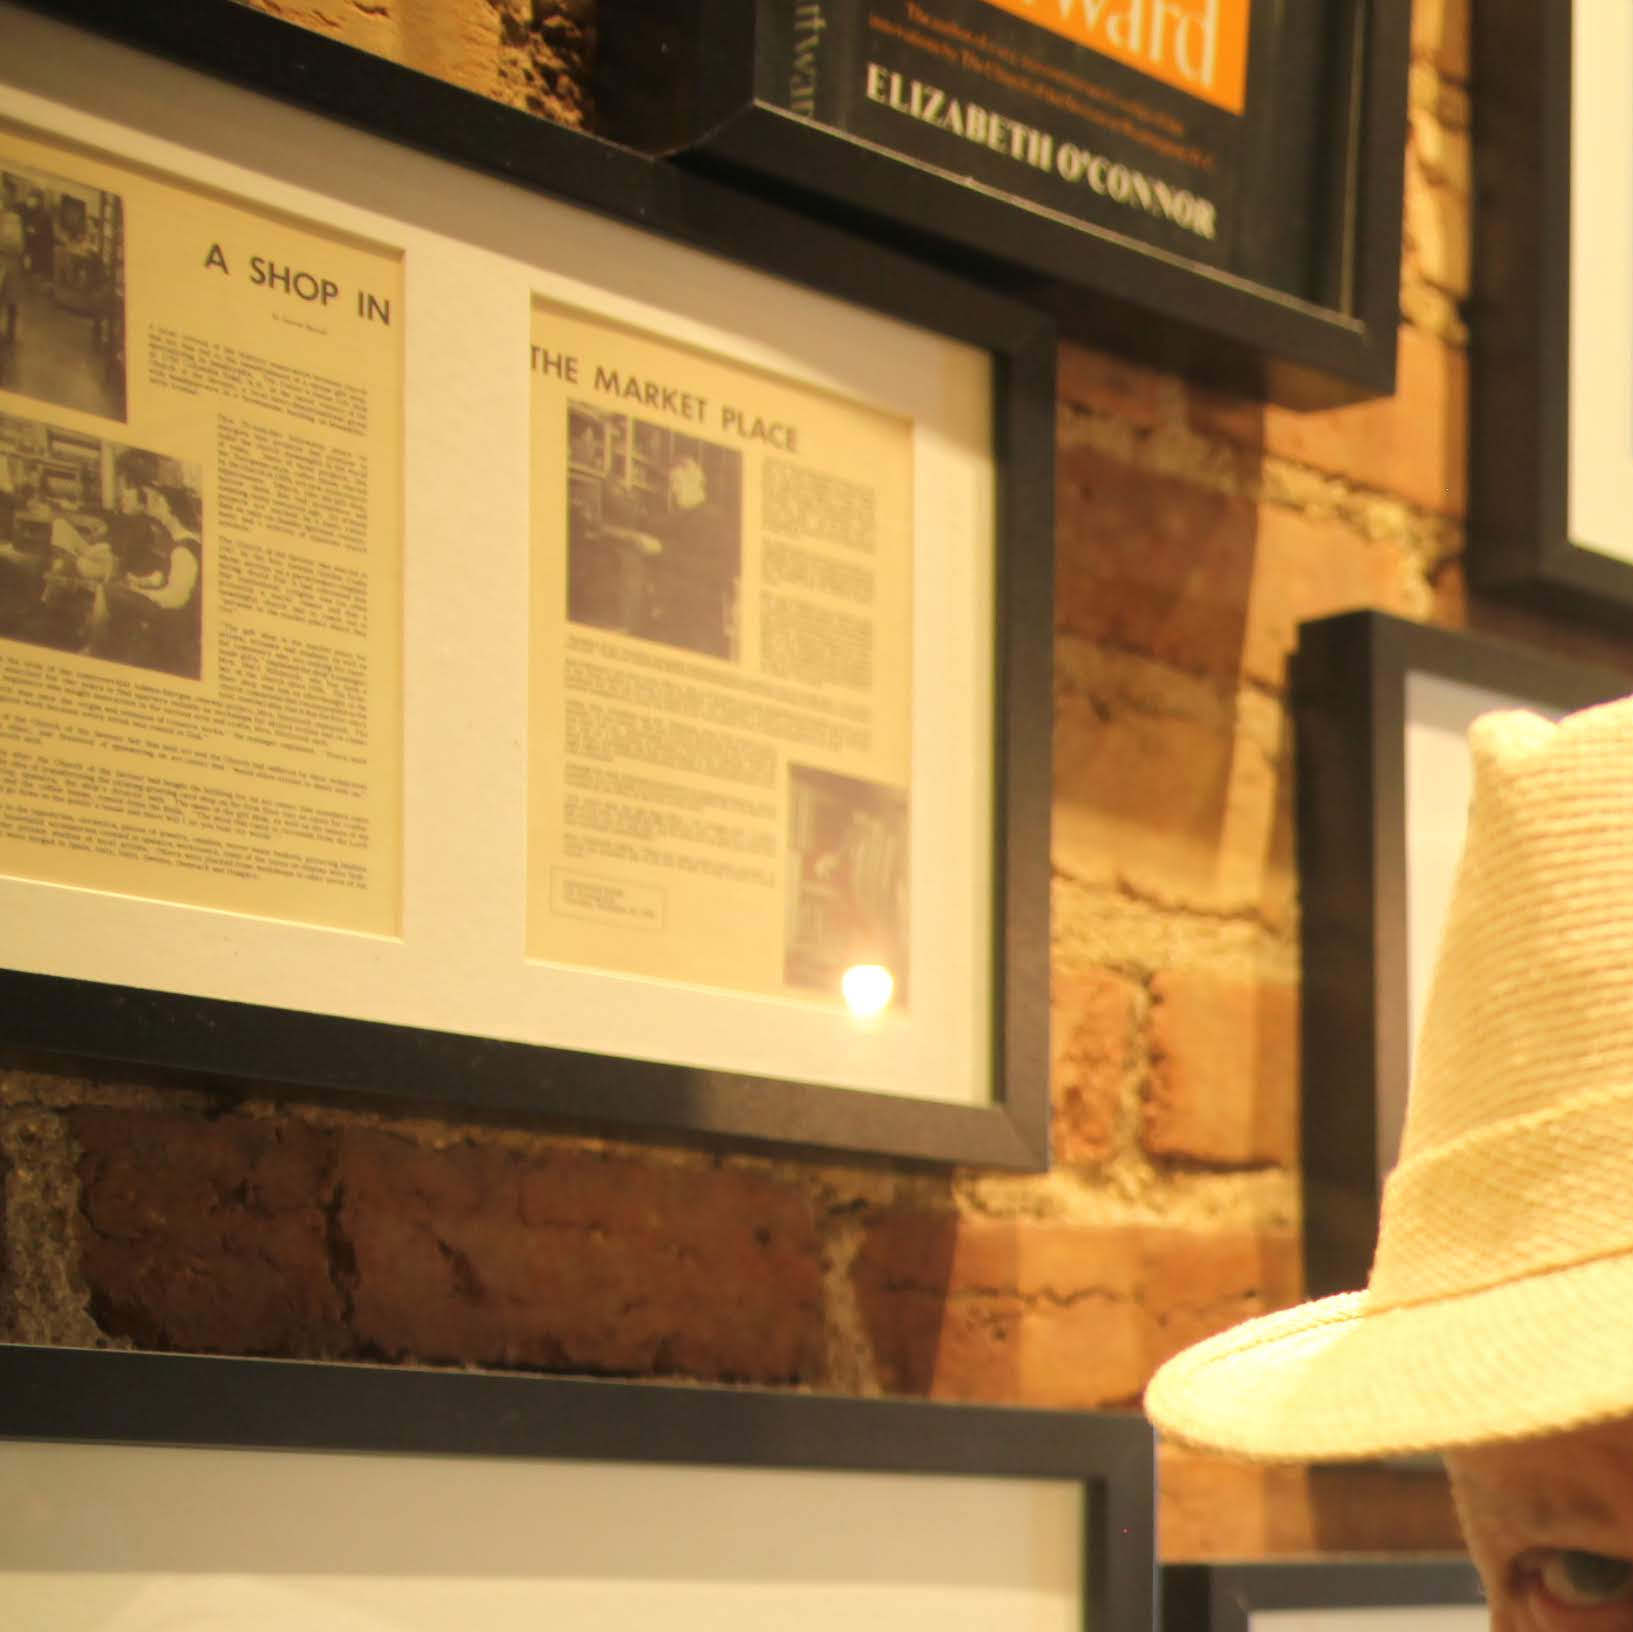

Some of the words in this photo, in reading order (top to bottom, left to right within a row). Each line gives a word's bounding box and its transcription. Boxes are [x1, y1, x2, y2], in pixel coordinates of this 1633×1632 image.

[866, 61, 1053, 173] ELIZABETH
[1057, 142, 1215, 240] O'CONNOR
[204, 243, 229, 277] A
[250, 256, 339, 307] SHOP
[357, 291, 391, 327] IN
[531, 344, 578, 385] THE
[594, 365, 709, 425] MARKET
[721, 405, 799, 453] PLACE
